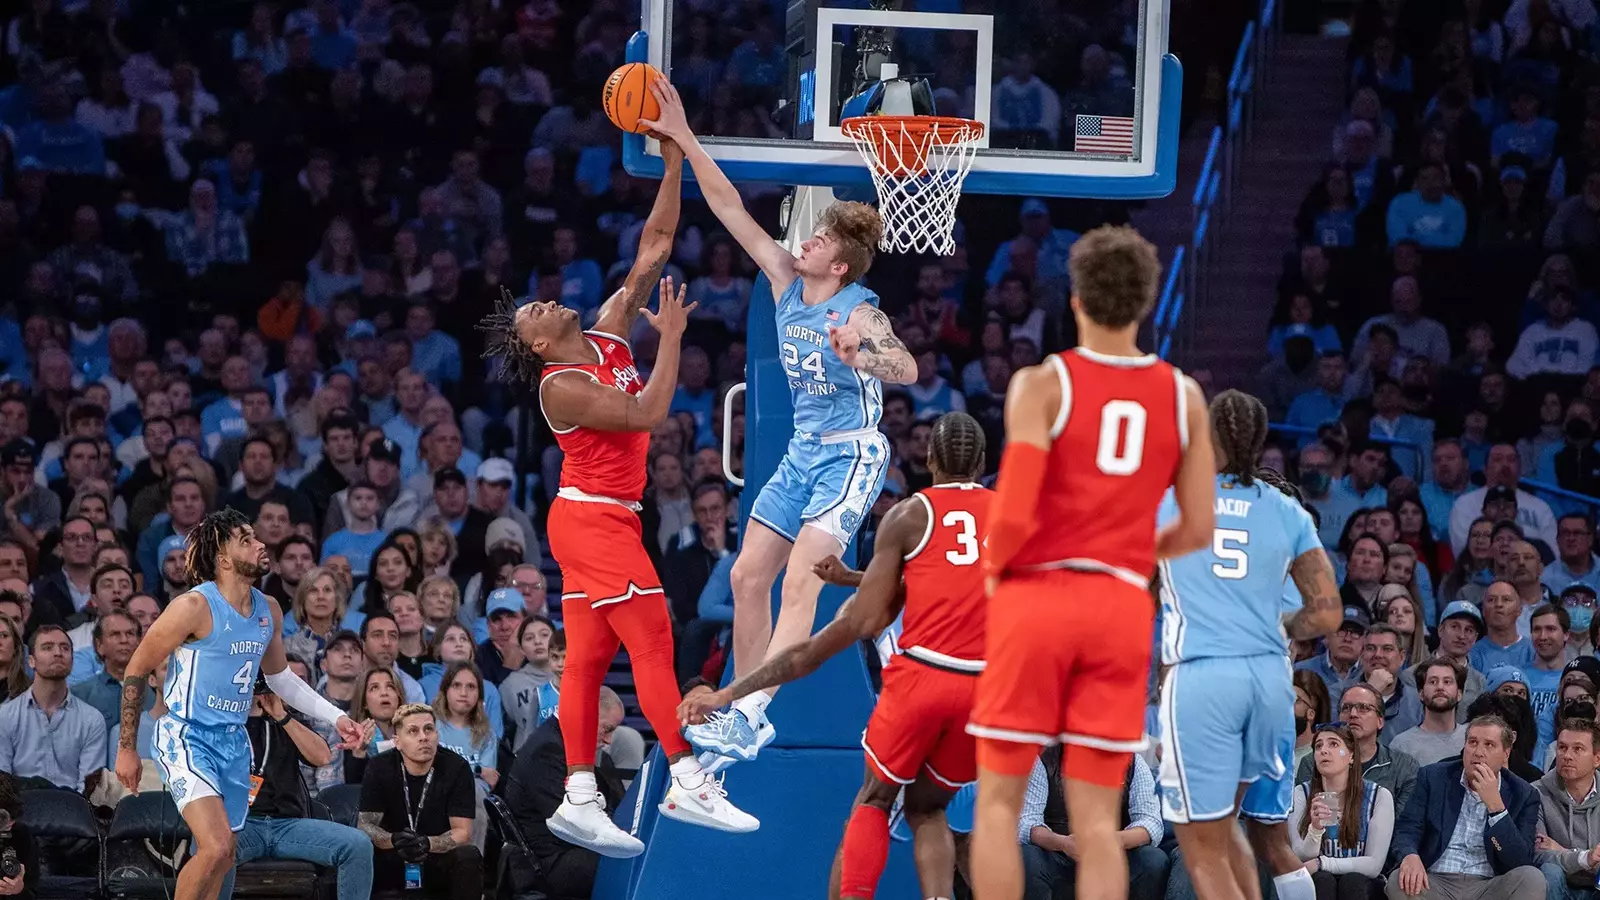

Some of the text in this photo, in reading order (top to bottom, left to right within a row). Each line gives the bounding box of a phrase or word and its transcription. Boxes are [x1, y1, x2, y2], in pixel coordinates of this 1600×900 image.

[785, 325, 824, 347] NORTH
[782, 341, 827, 382] 24
[1096, 399, 1148, 476] 0
[1213, 498, 1252, 518] ACOT
[1211, 527, 1249, 580] 5
[229, 640, 265, 657] NORTH
[232, 660, 253, 695] 4
